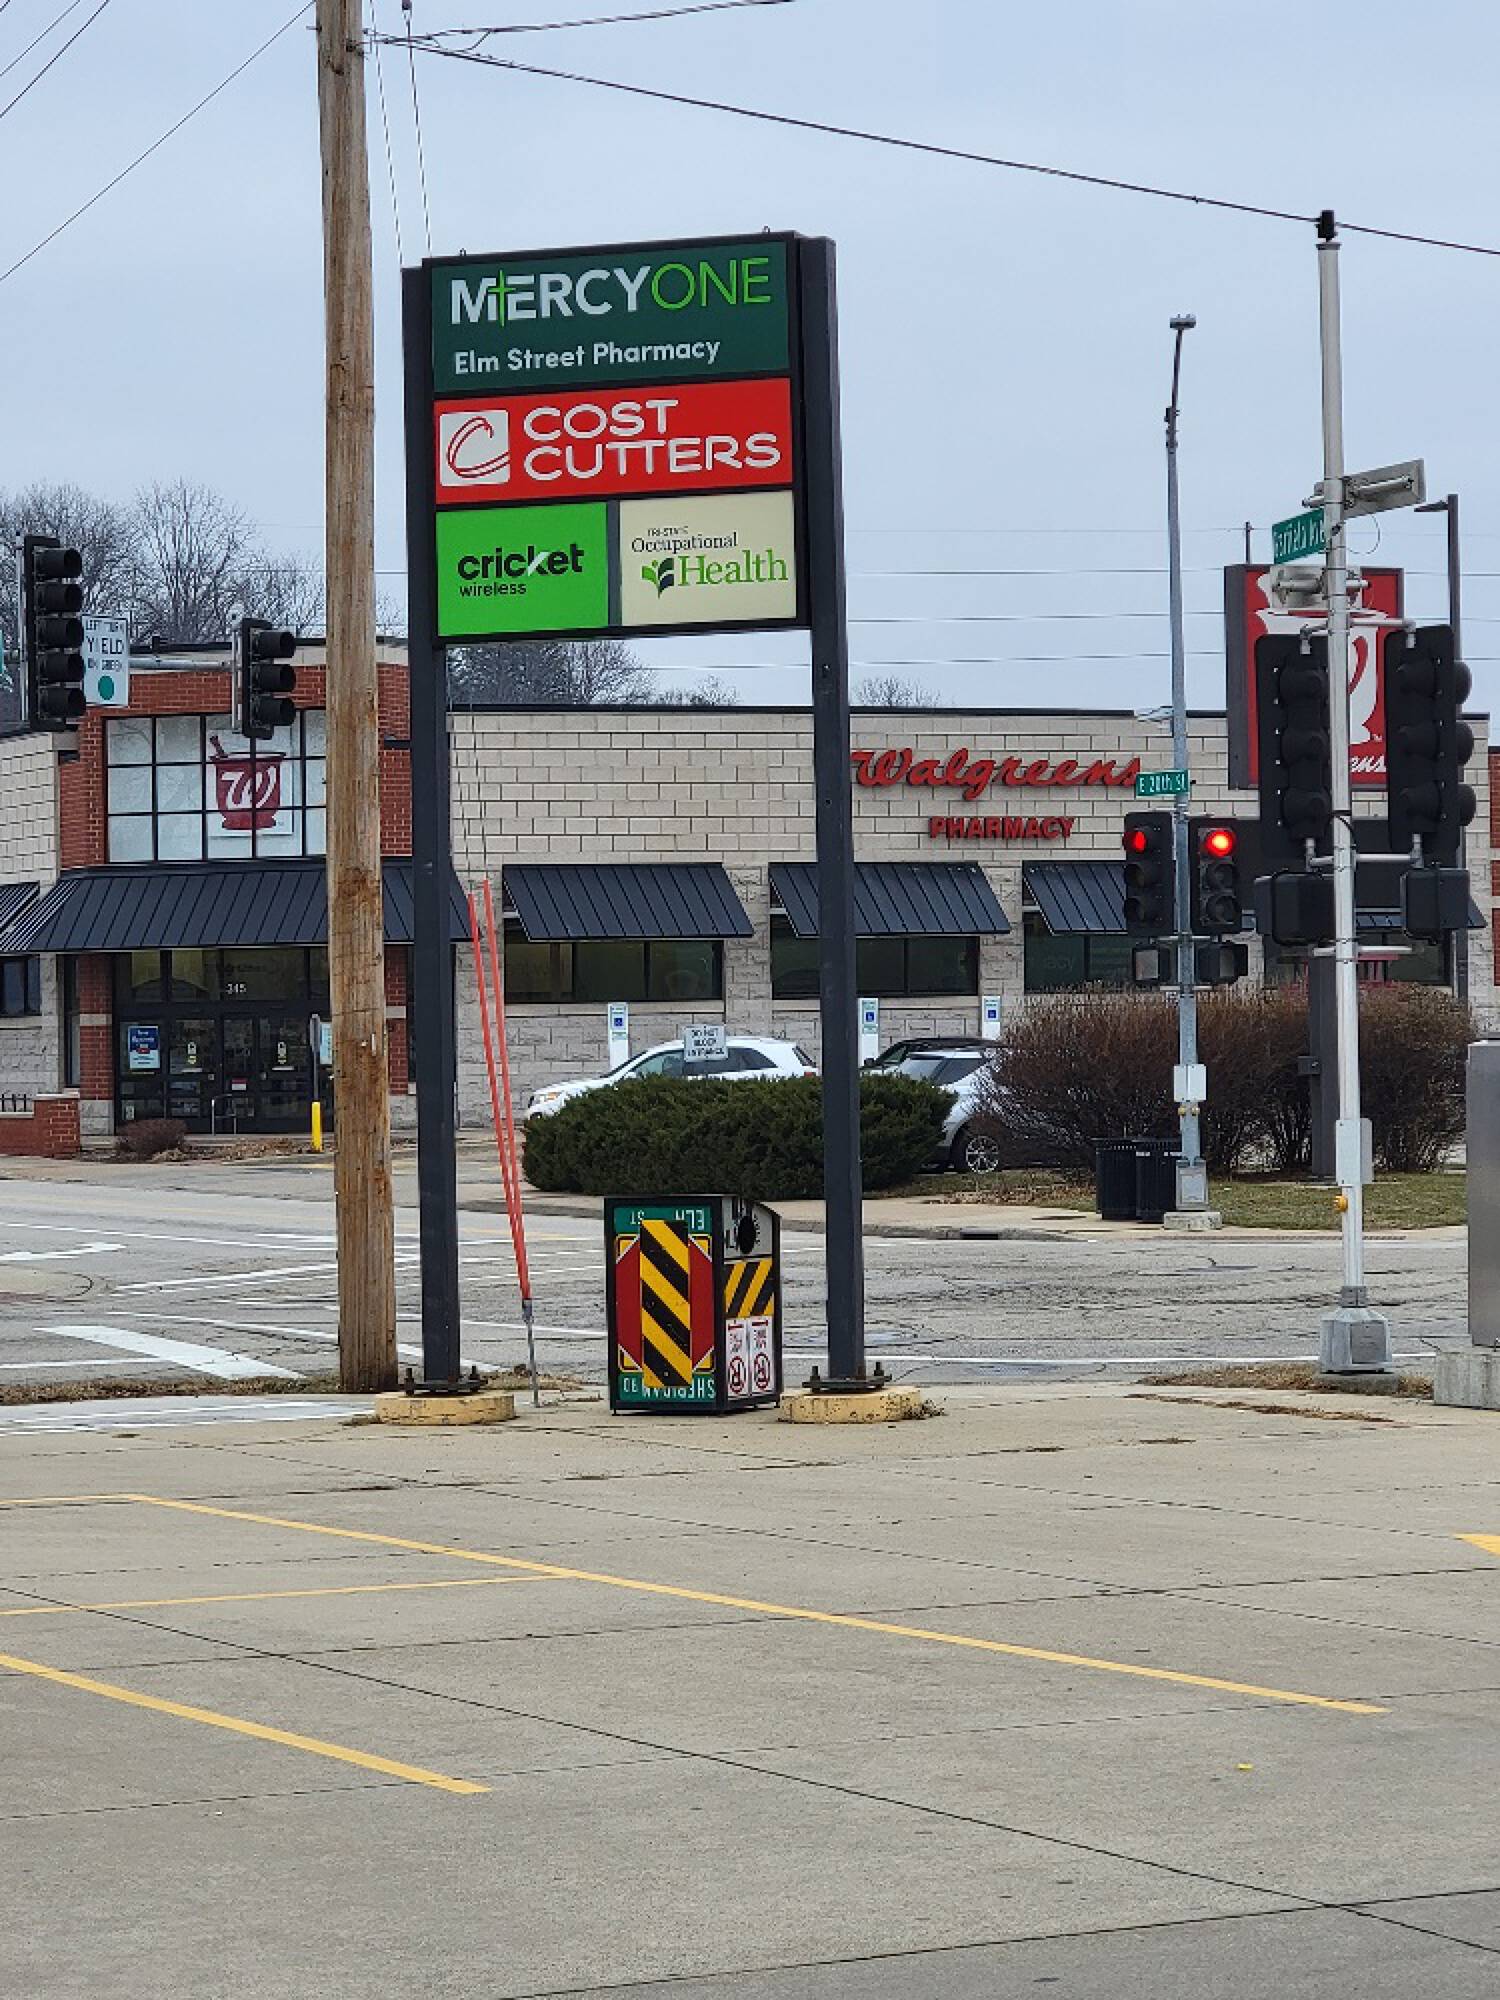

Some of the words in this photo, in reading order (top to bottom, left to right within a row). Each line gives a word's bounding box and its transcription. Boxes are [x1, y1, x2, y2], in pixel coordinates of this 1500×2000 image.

[455, 350, 499, 375] Elm
[507, 345, 585, 371] Street
[593, 341, 721, 365] Pharmacy
[523, 399, 679, 441] COST
[523, 432, 782, 482] CUTTERS
[631, 531, 738, 554] Occupational
[457, 543, 585, 580] cricket
[678, 548, 789, 587] Health
[459, 581, 527, 597] wireless
[852, 747, 1141, 801] Walgreens
[929, 816, 1075, 840] PHARMACY
